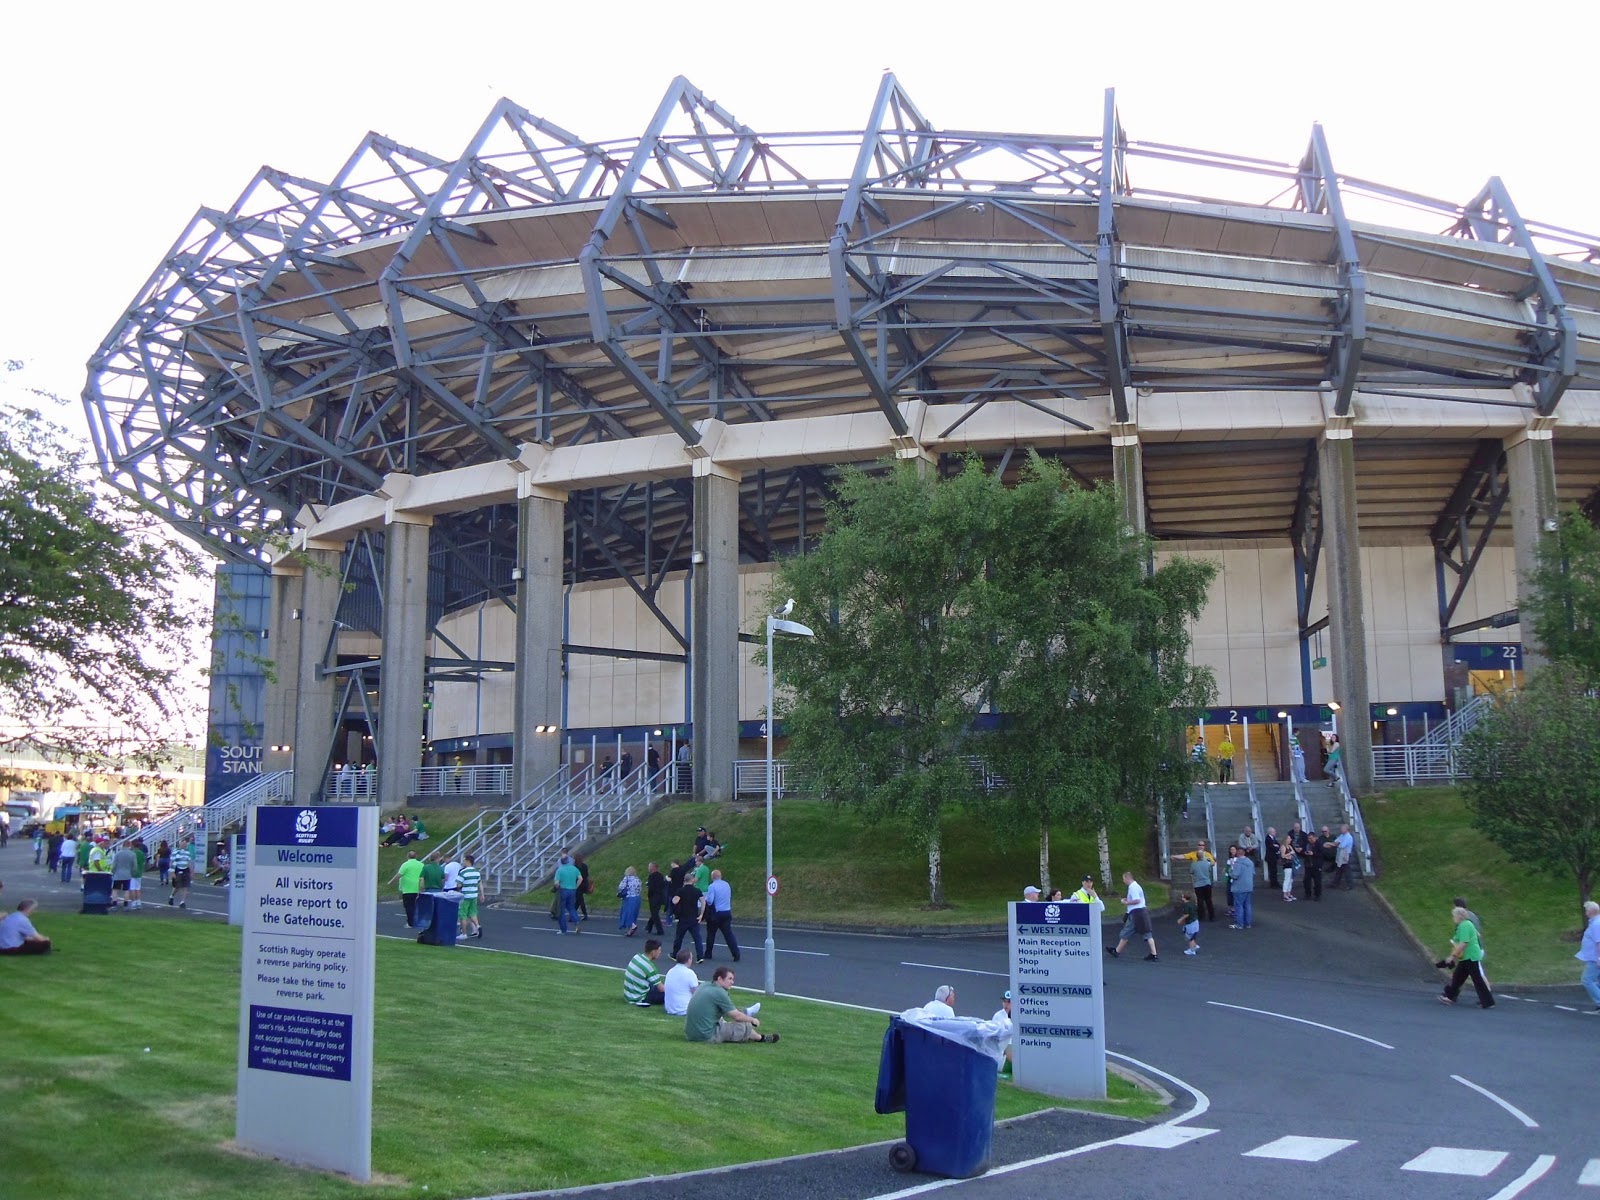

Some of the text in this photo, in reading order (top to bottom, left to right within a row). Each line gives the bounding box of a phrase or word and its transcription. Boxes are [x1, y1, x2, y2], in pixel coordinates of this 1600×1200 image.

[1502, 646, 1517, 658] 22
[1229, 710, 1238, 722] 2
[759, 723, 767, 734] 4
[220, 745, 263, 759] SOUT
[278, 850, 333, 863] Welcome
[276, 877, 333, 890] All visitors
[769, 881, 777, 890] 10
[260, 894, 348, 910] please report to
[262, 912, 345, 928] the Gatehouse.
[1031, 926, 1088, 935] WEST STAND
[1018, 938, 1081, 948] Main Reception
[259, 944, 346, 959] Scottish Rugby operate
[1018, 948, 1062, 957] Hospitality
[263, 959, 290, 968] reverse
[292, 961, 321, 972] parking
[323, 963, 348, 973] policy.
[1018, 958, 1039, 966] Shop
[1018, 967, 1049, 976] Parking
[257, 974, 346, 990] Please take the time to
[276, 990, 326, 1001] reverse park.
[1031, 986, 1092, 995] SOUTH STAND
[1020, 998, 1049, 1006] Offices
[256, 1010, 266, 1019] Use
[297, 1015, 321, 1025] facilities
[1020, 1008, 1051, 1017] Parking
[258, 1023, 274, 1031] user's
[287, 1026, 310, 1035] Scottish
[310, 1028, 328, 1038] Rugby
[328, 1030, 342, 1039] does
[1020, 1026, 1081, 1037] TICKET CENTRE
[264, 1035, 283, 1044] accept
[283, 1037, 305, 1047] liability
[305, 1039, 315, 1047] for
[314, 1041, 326, 1050] any
[326, 1042, 338, 1050] loss
[337, 1043, 346, 1051] of
[1020, 1038, 1052, 1048] Parking
[260, 1045, 282, 1056] damage
[289, 1049, 312, 1058] vehicles
[320, 1054, 346, 1064] property
[277, 1060, 293, 1069] using
[292, 1060, 309, 1069] these
